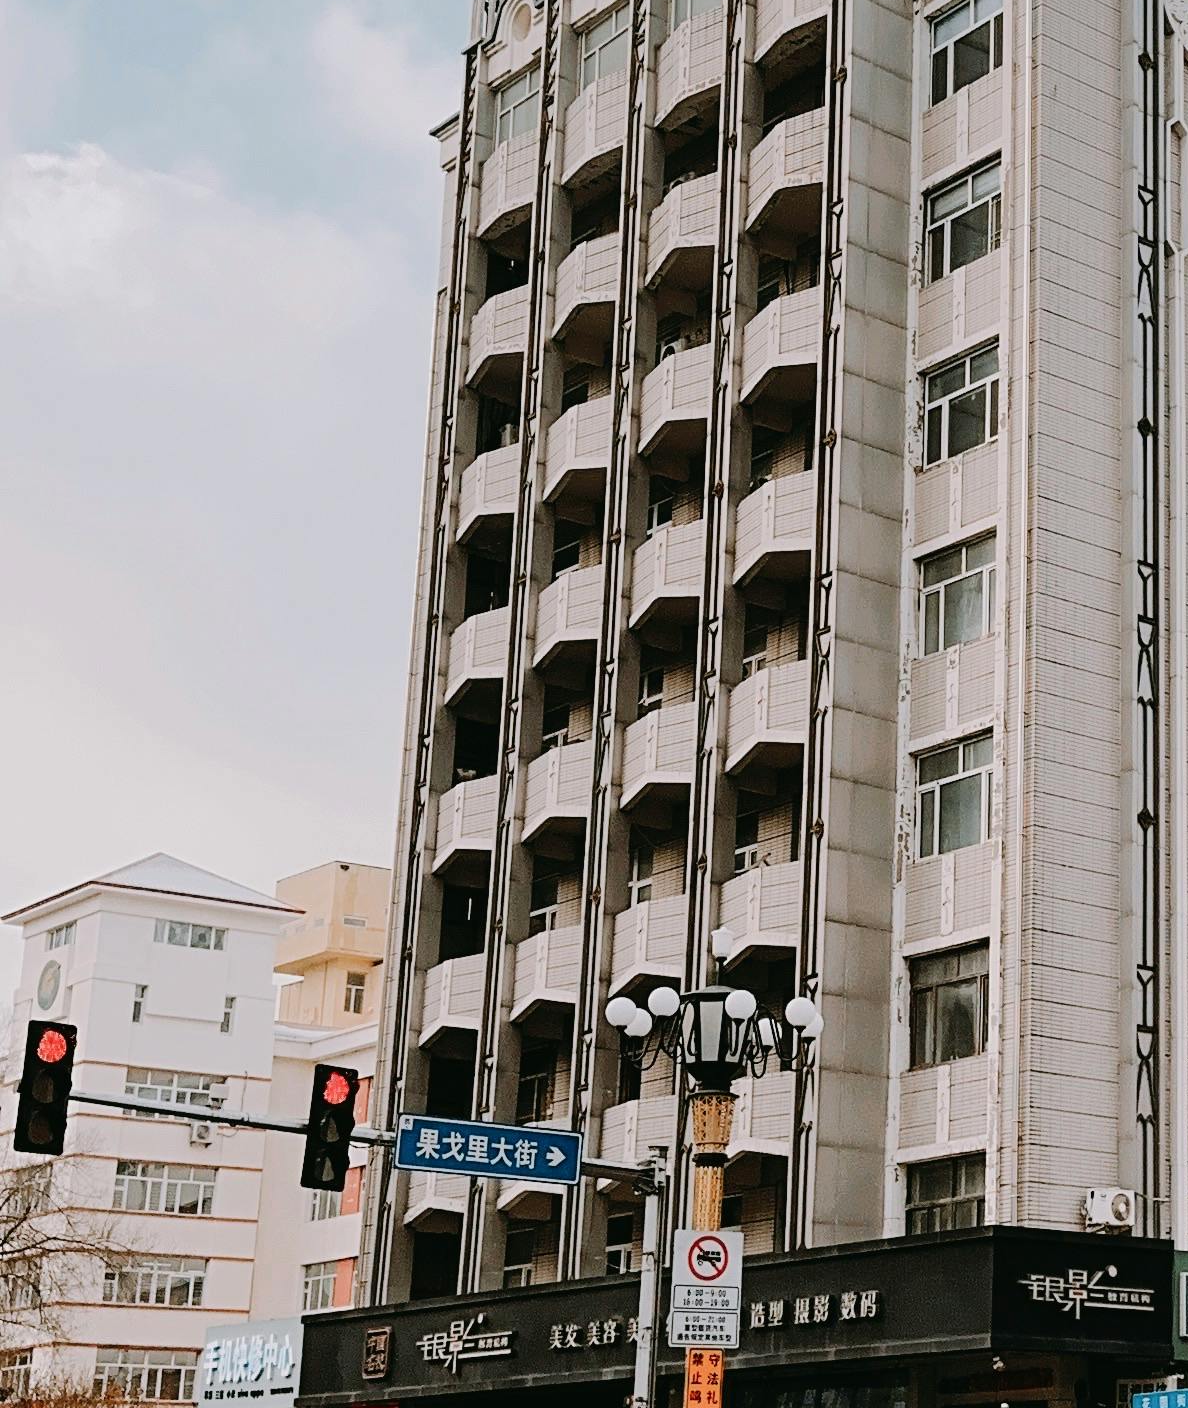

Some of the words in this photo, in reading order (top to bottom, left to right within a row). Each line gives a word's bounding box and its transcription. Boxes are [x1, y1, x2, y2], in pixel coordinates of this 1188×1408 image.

[415, 1128, 538, 1170] 果戈里大街
[549, 1324, 582, 1349] 美发
[587, 1319, 616, 1345] 美容
[750, 1301, 783, 1329] 造型
[794, 1295, 829, 1325] 摄影
[840, 1290, 878, 1320] 数码
[204, 1334, 294, 1385] 手机快修中心
